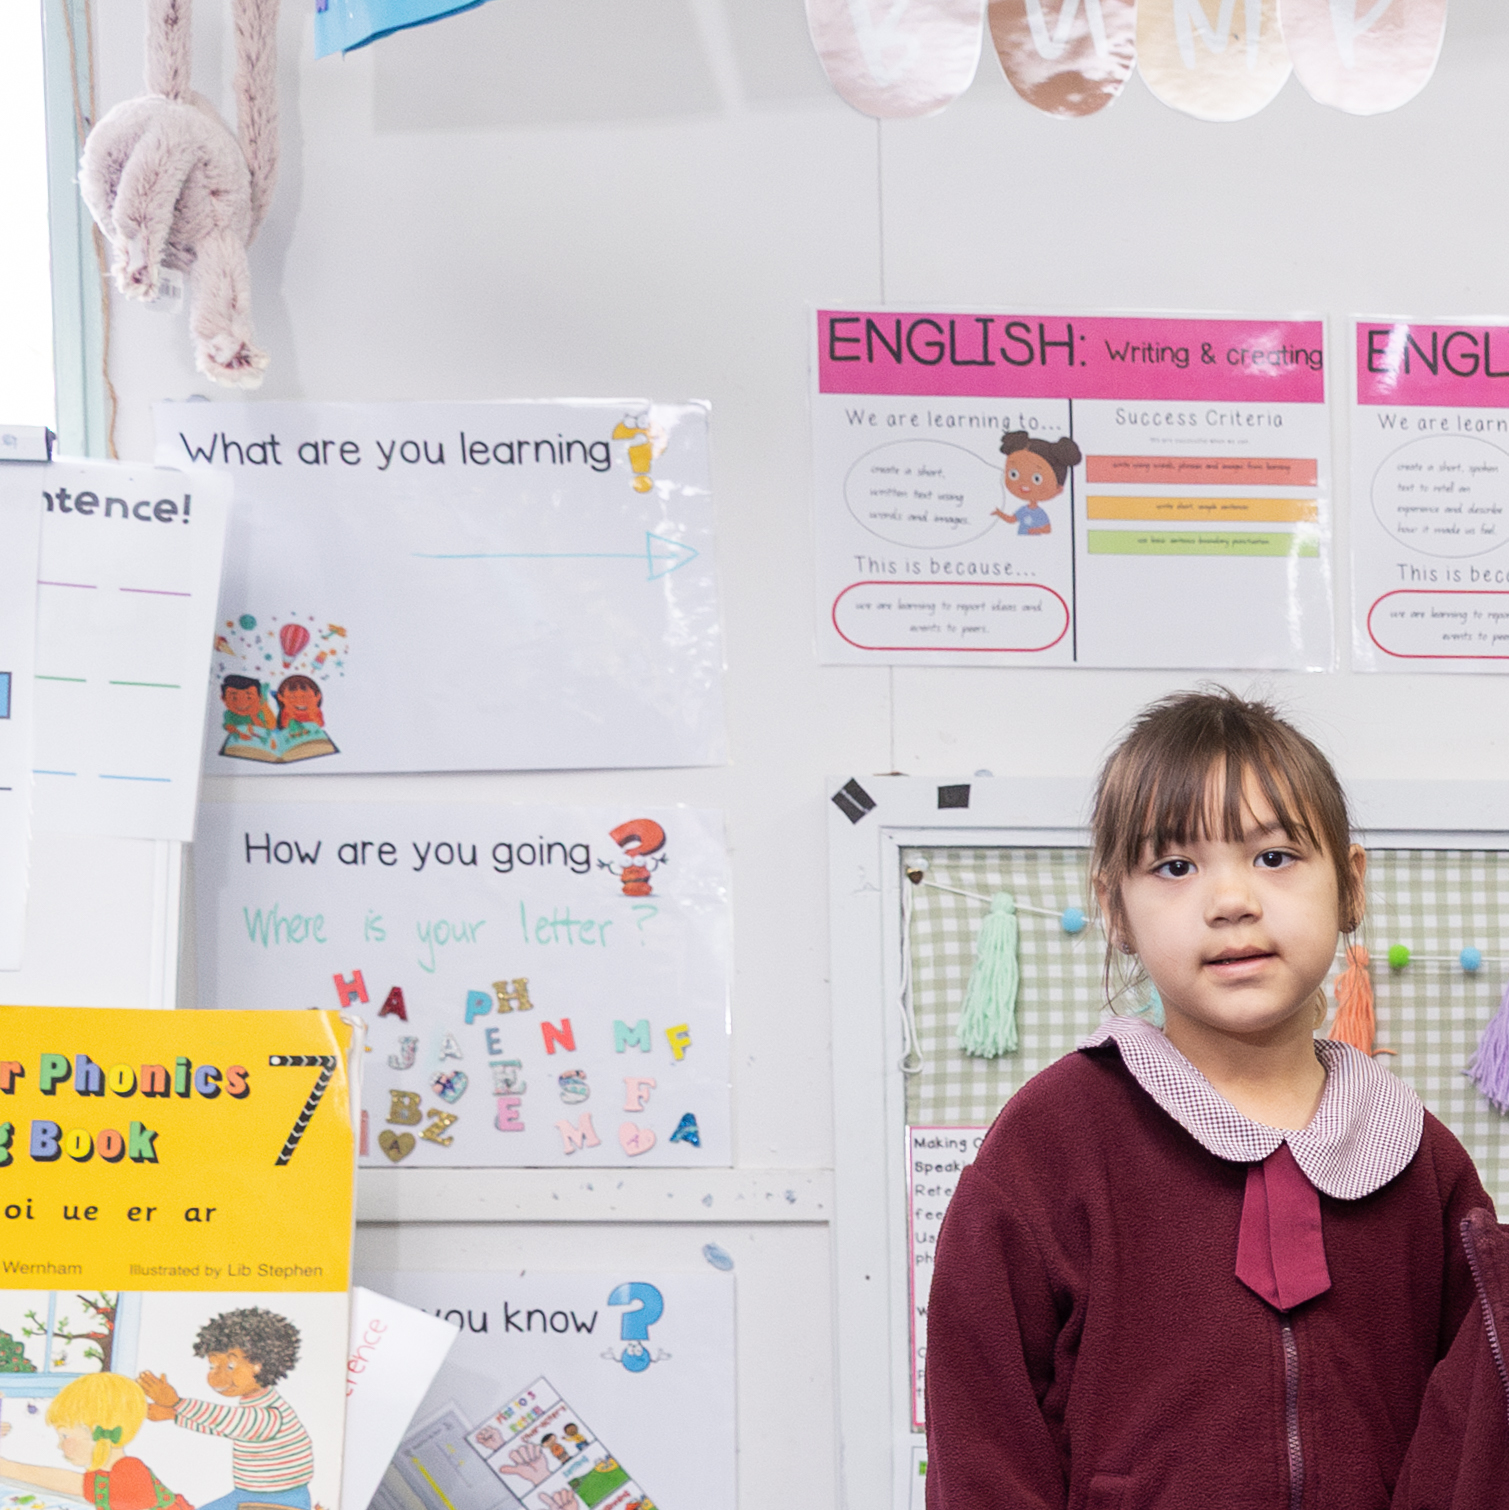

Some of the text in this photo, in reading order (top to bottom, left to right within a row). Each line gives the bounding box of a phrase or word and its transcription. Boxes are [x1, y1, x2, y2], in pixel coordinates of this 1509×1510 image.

[828, 318, 1323, 372] ENGLISH: Writing & creating
[845, 409, 877, 427] We
[887, 413, 919, 427] are
[928, 411, 1011, 433] learning
[1116, 408, 1283, 427] Success Criteria
[1378, 414, 1408, 430] We
[1418, 418, 1448, 430] are
[179, 432, 612, 472] What are you learning
[854, 555, 897, 574] This
[906, 558, 921, 574] is
[1397, 564, 1438, 582] This
[1446, 566, 1461, 582] is
[246, 832, 591, 873] How are you going
[244, 903, 328, 948] Where
[364, 909, 387, 943] is
[417, 918, 486, 973] your
[520, 900, 613, 947] letter
[39, 1053, 250, 1098] Phonics
[269, 1055, 337, 1166] 7
[30, 1119, 159, 1164] Book
[914, 1137, 967, 1152] Making
[5, 1198, 217, 1222] oi ue er ar
[2, 1260, 323, 1280] Wernham Illustrated by Lib Stephen
[504, 1302, 598, 1334] know
